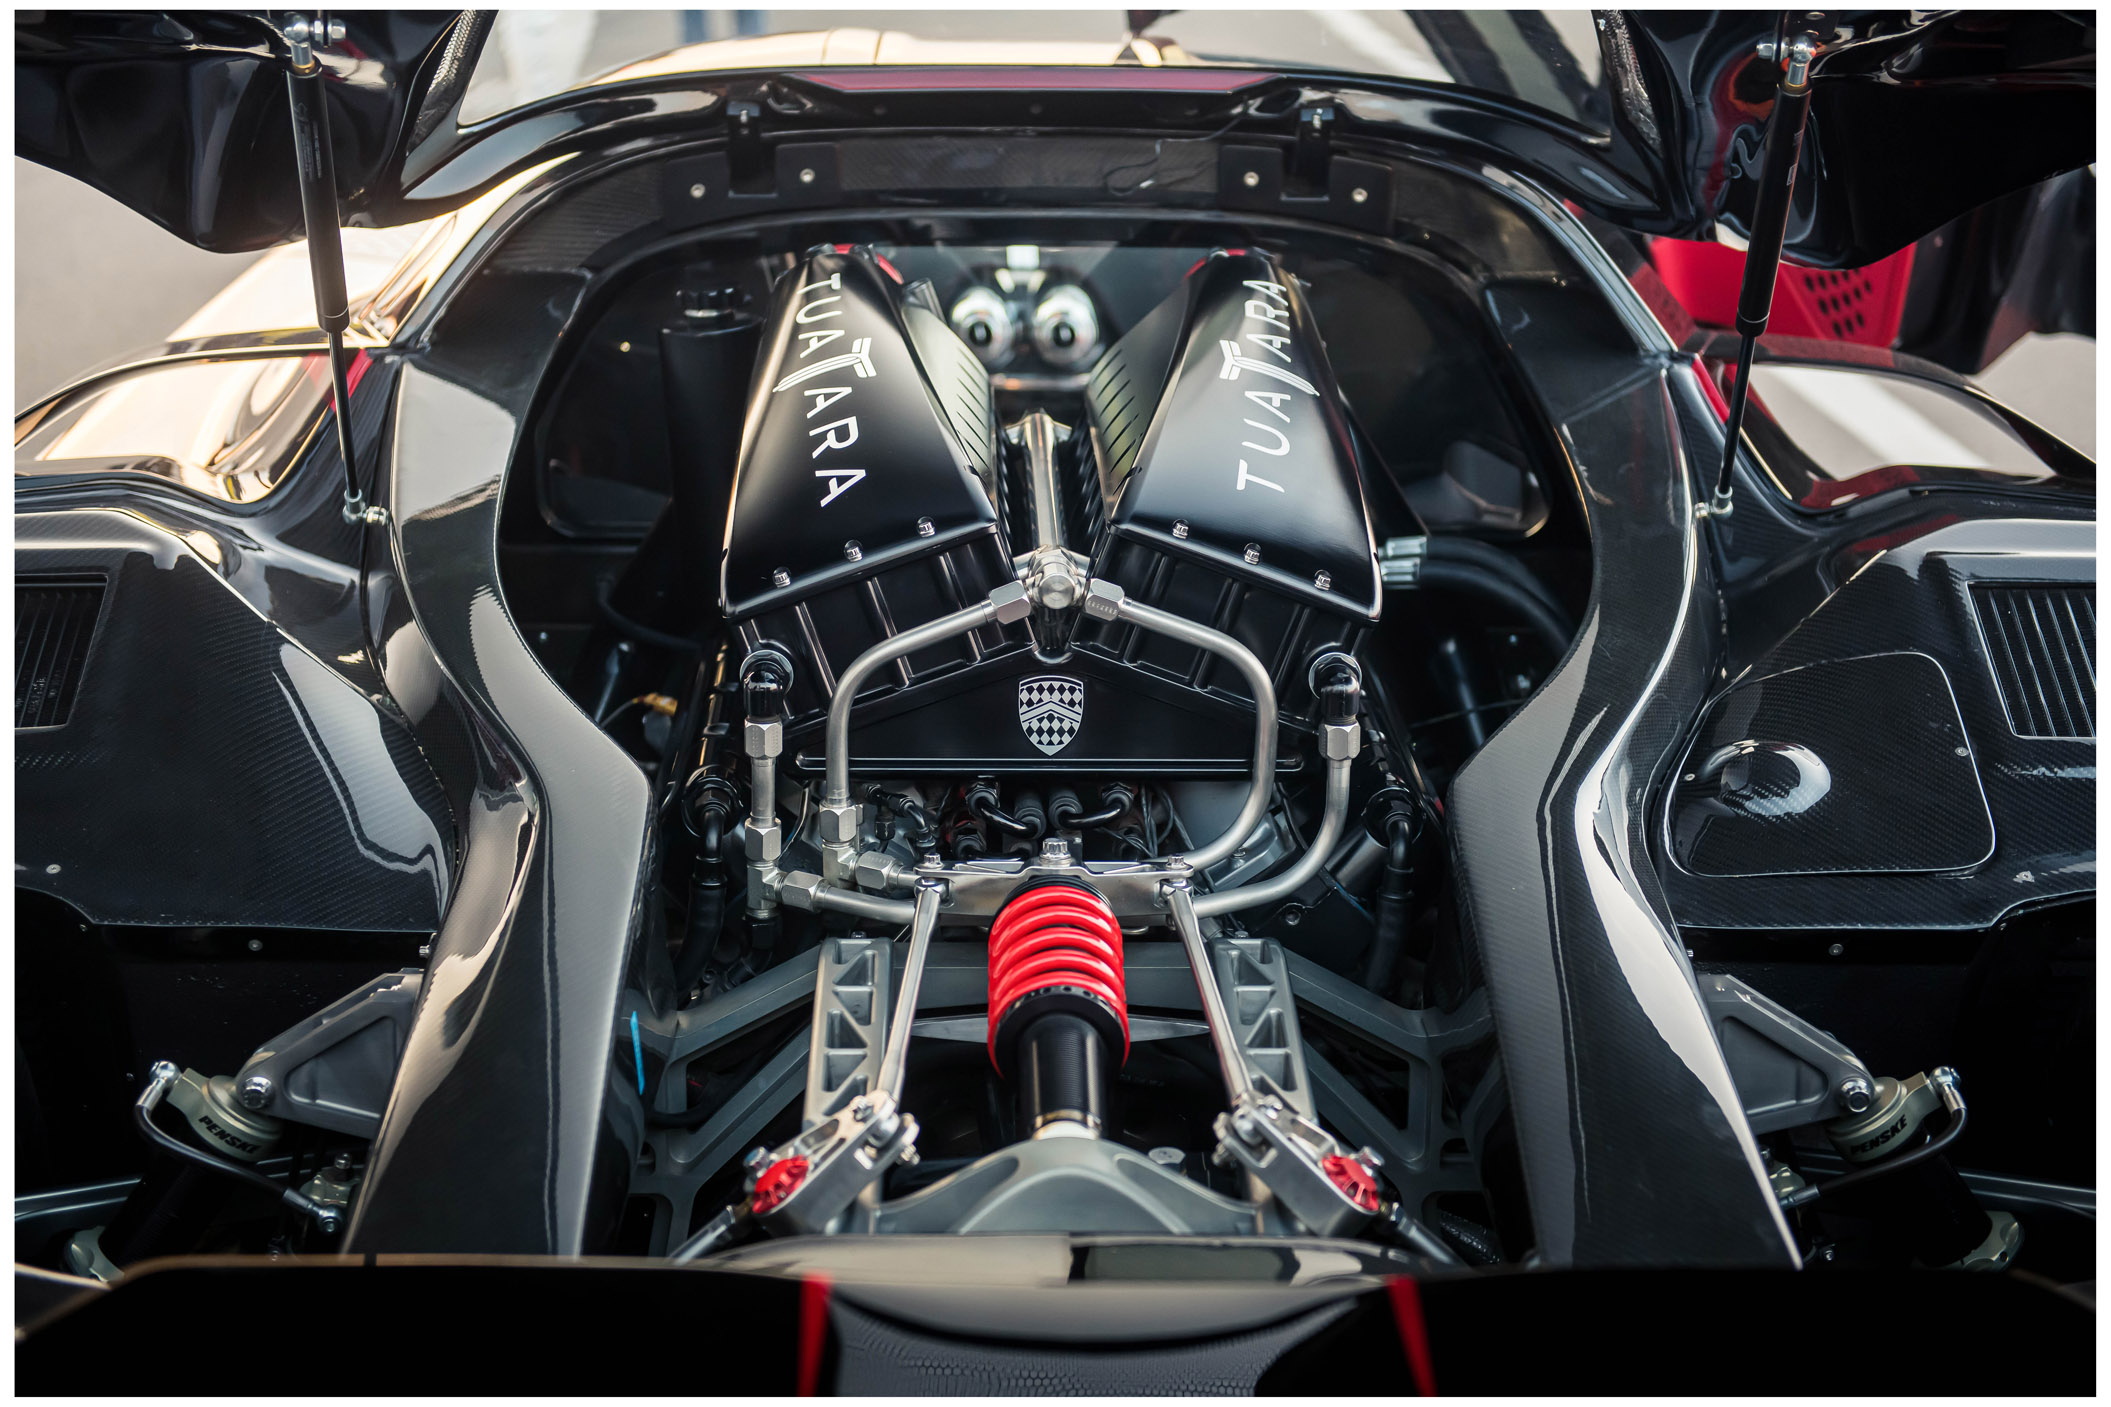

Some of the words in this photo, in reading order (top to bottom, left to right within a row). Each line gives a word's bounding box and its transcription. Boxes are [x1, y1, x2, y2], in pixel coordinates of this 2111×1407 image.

[772, 272, 877, 508] TUATARA
[1219, 280, 1320, 493] TUATARA
[198, 1115, 261, 1154] PENSKE
[1850, 1114, 1907, 1155] PENSKE
